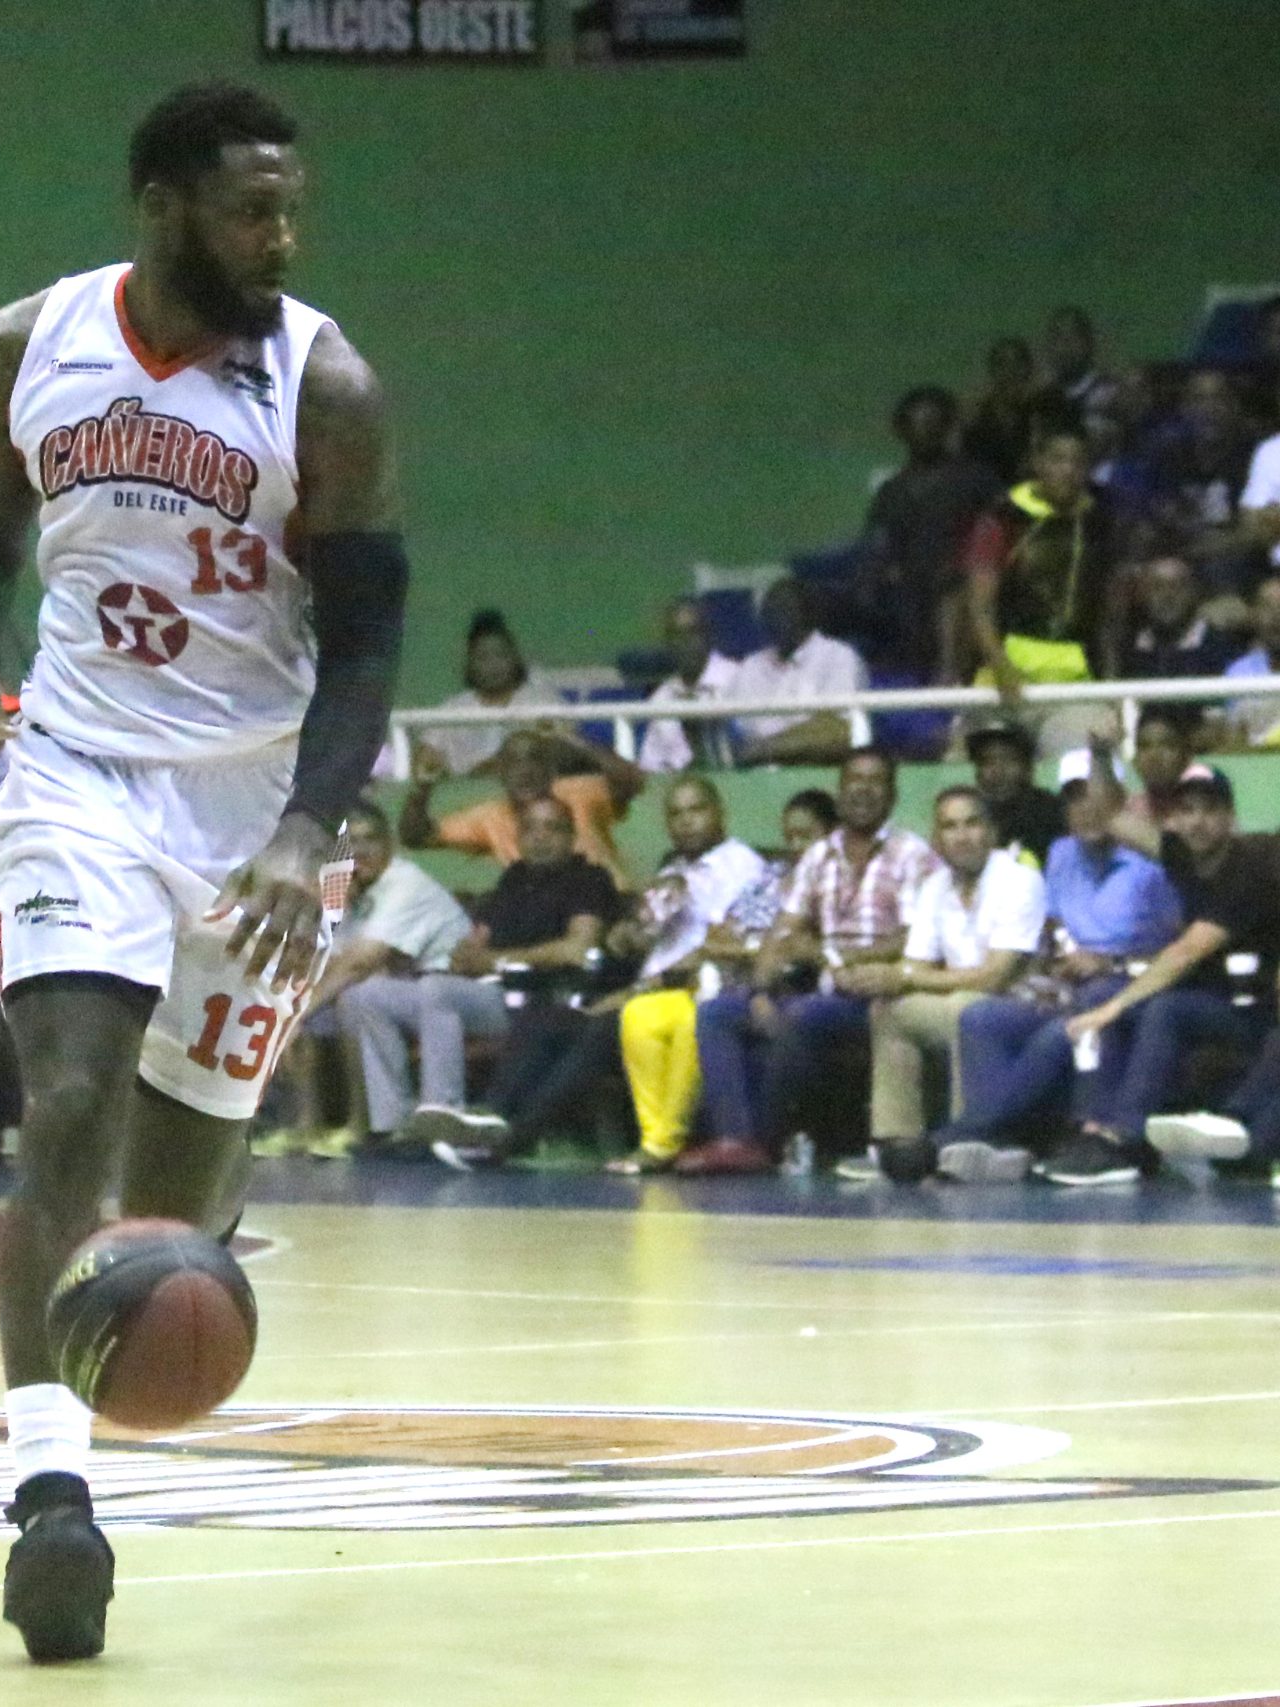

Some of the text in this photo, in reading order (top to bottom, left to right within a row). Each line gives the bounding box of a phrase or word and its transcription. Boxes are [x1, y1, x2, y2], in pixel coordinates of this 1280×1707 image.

[264, 0, 534, 53] PALCOS OESTE
[40, 397, 258, 524] CAÑEROS
[113, 490, 188, 516] DEL ESTE
[186, 527, 267, 595] 13
[186, 993, 277, 1081] 13
